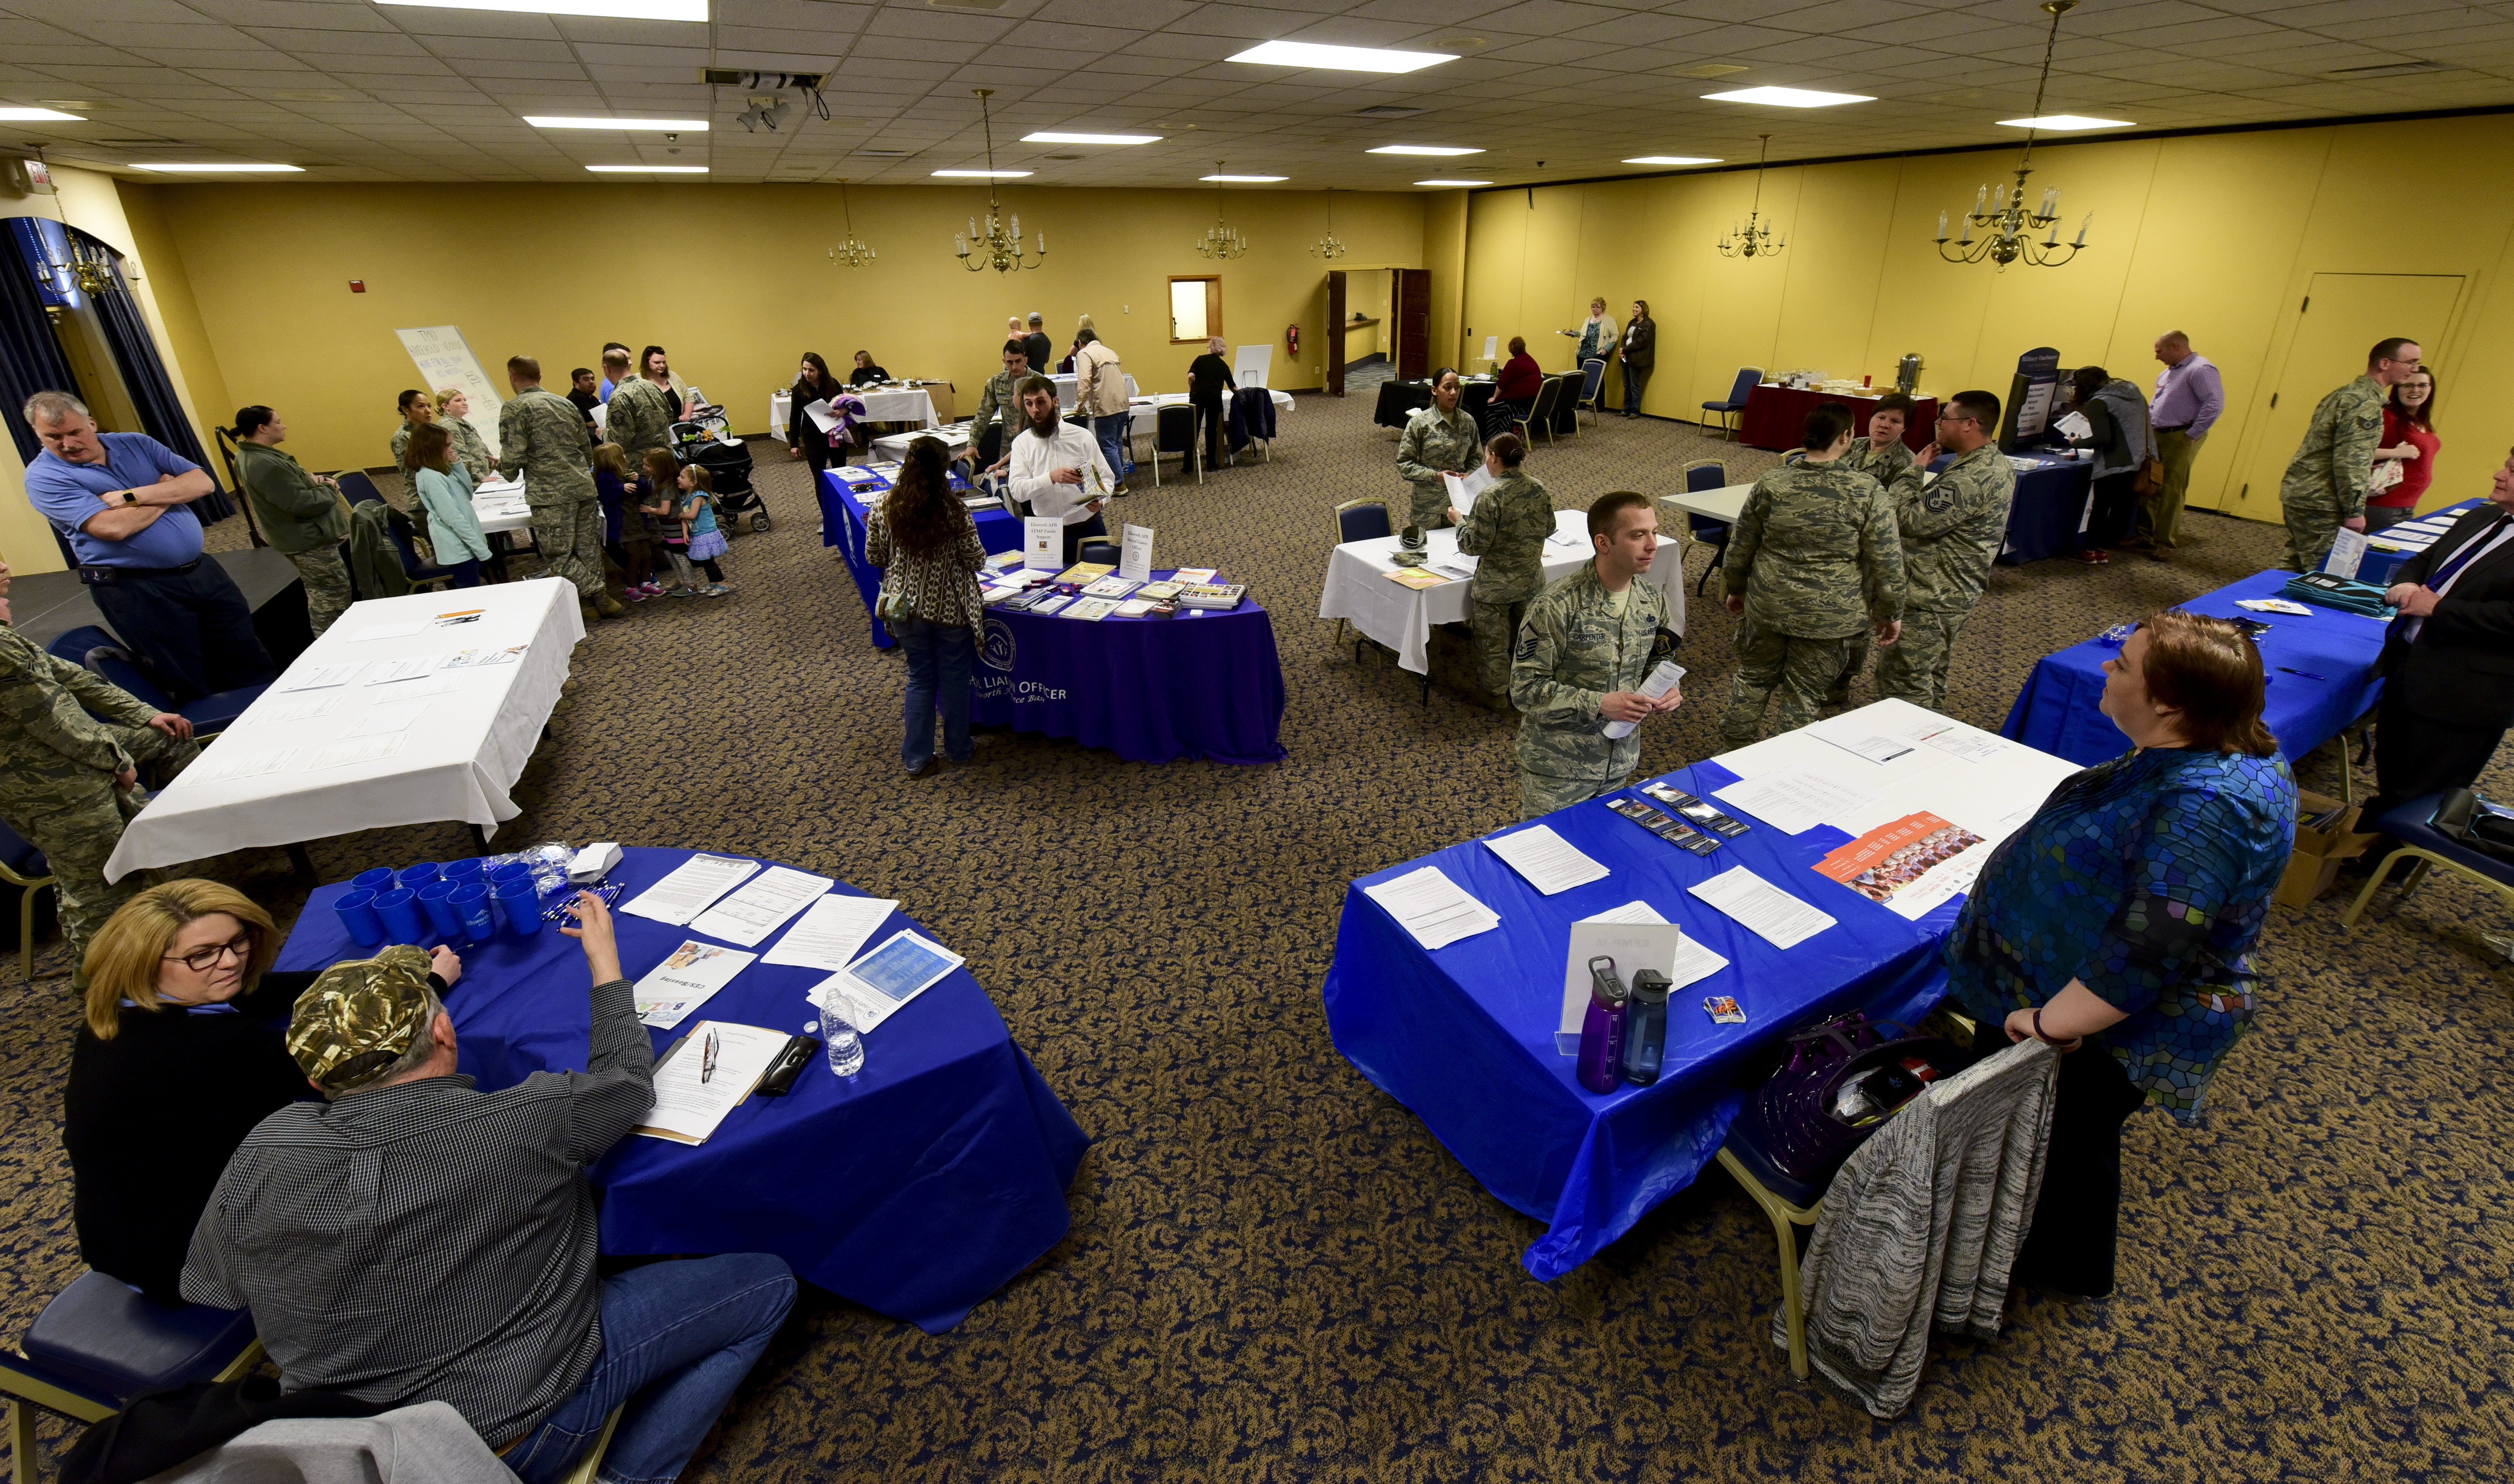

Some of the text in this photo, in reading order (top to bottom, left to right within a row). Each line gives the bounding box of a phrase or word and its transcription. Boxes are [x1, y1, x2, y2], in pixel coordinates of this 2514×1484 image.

[407, 344, 439, 357] HOUSEHOLD
[1019, 681, 1066, 699] OFFICER
[466, 914, 489, 926] Ellsworth
[659, 976, 705, 989] CES/Housing
[649, 1011, 684, 1020] PCS
